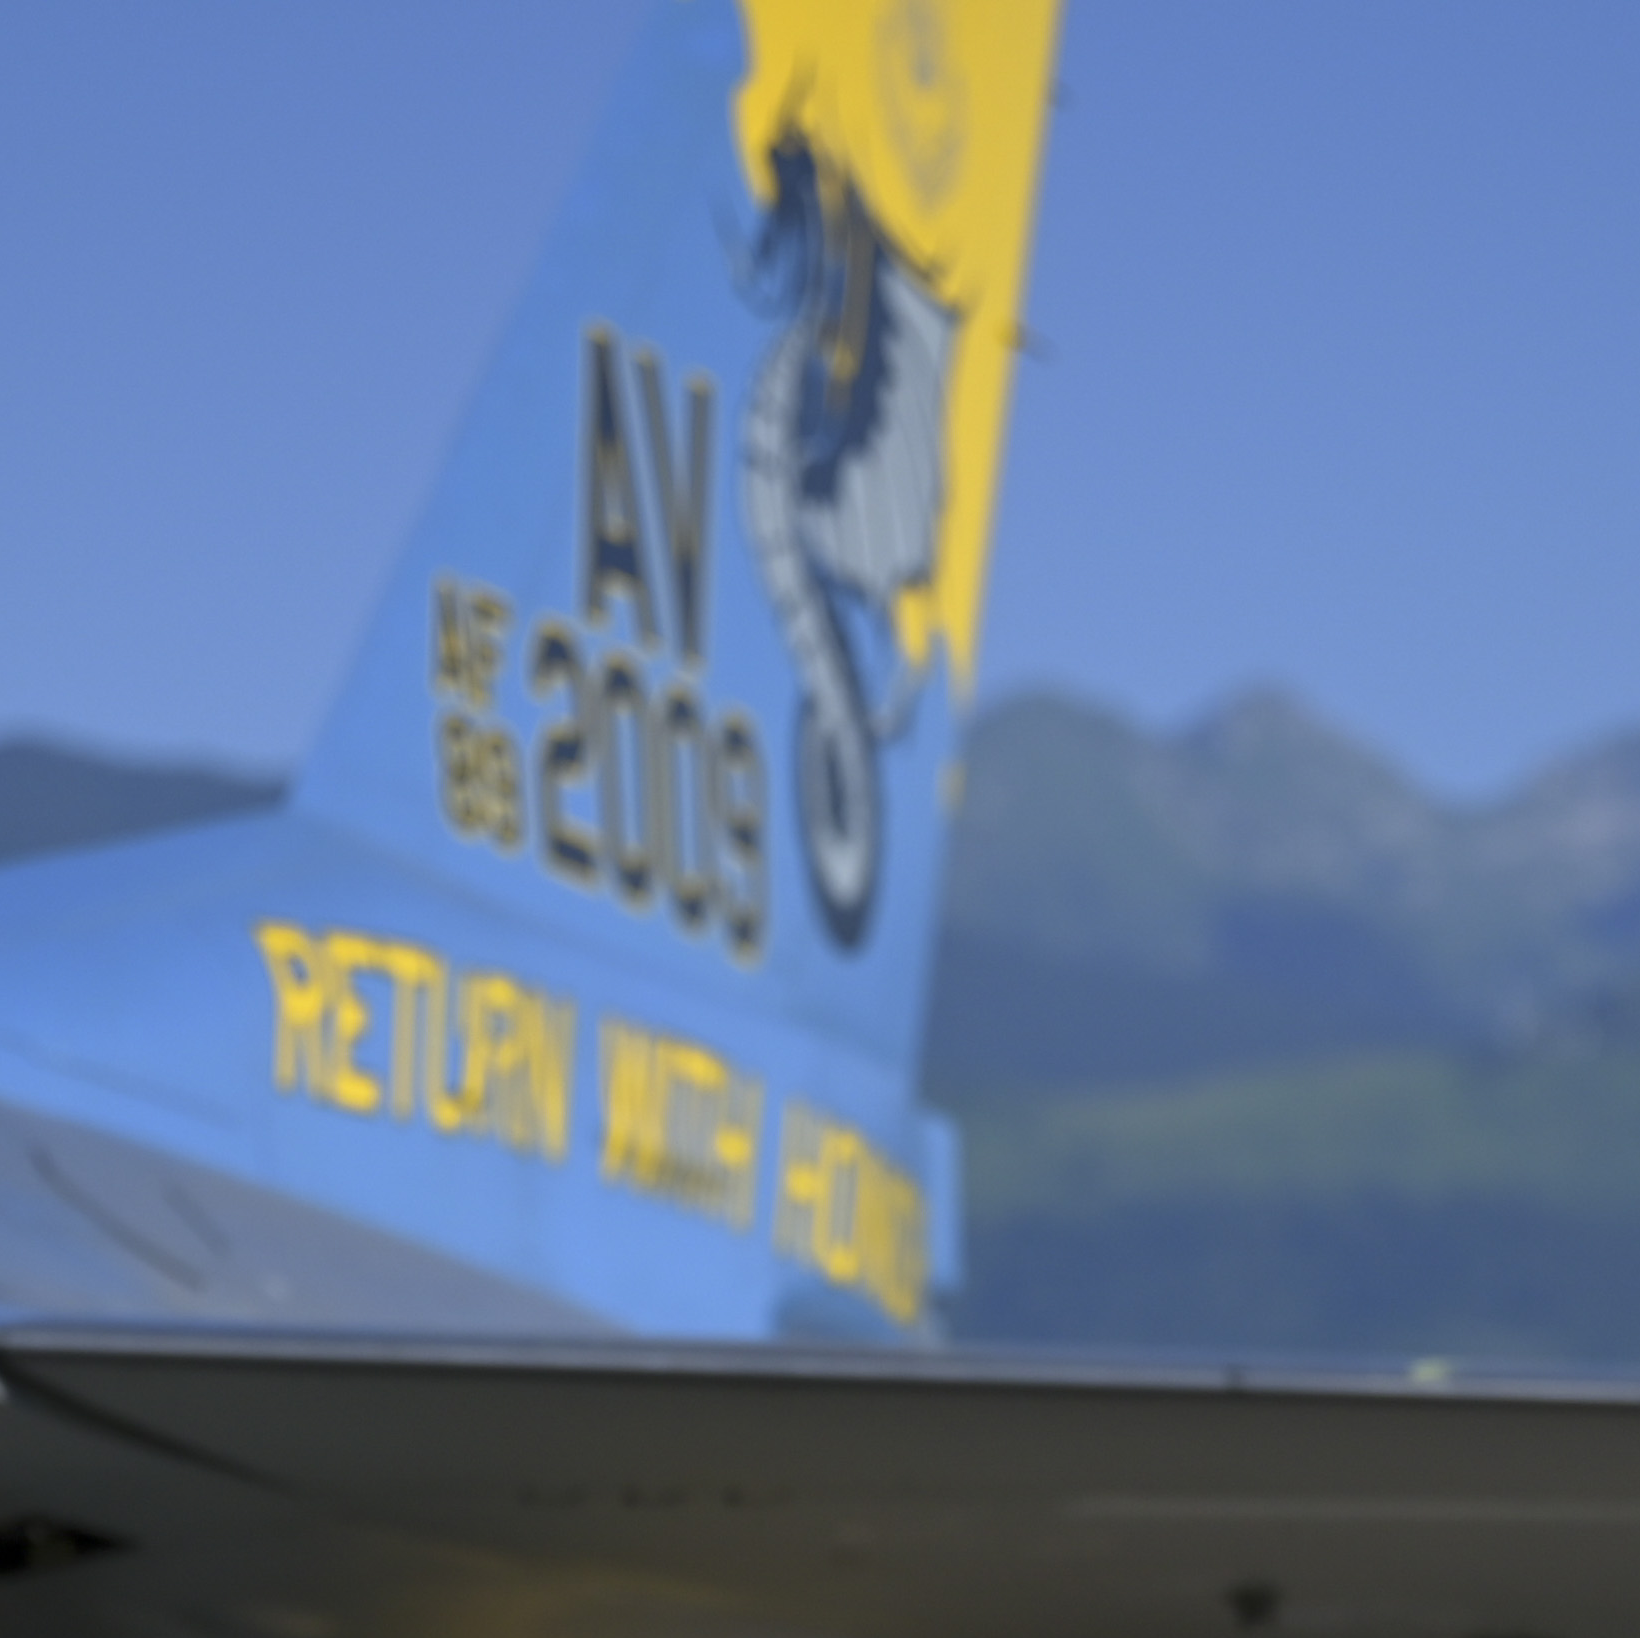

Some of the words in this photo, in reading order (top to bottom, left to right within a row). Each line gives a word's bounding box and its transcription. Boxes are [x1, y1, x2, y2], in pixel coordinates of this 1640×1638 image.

[574, 322, 717, 672] AV
[527, 617, 765, 965] 2009
[257, 920, 575, 1163] RETURN
